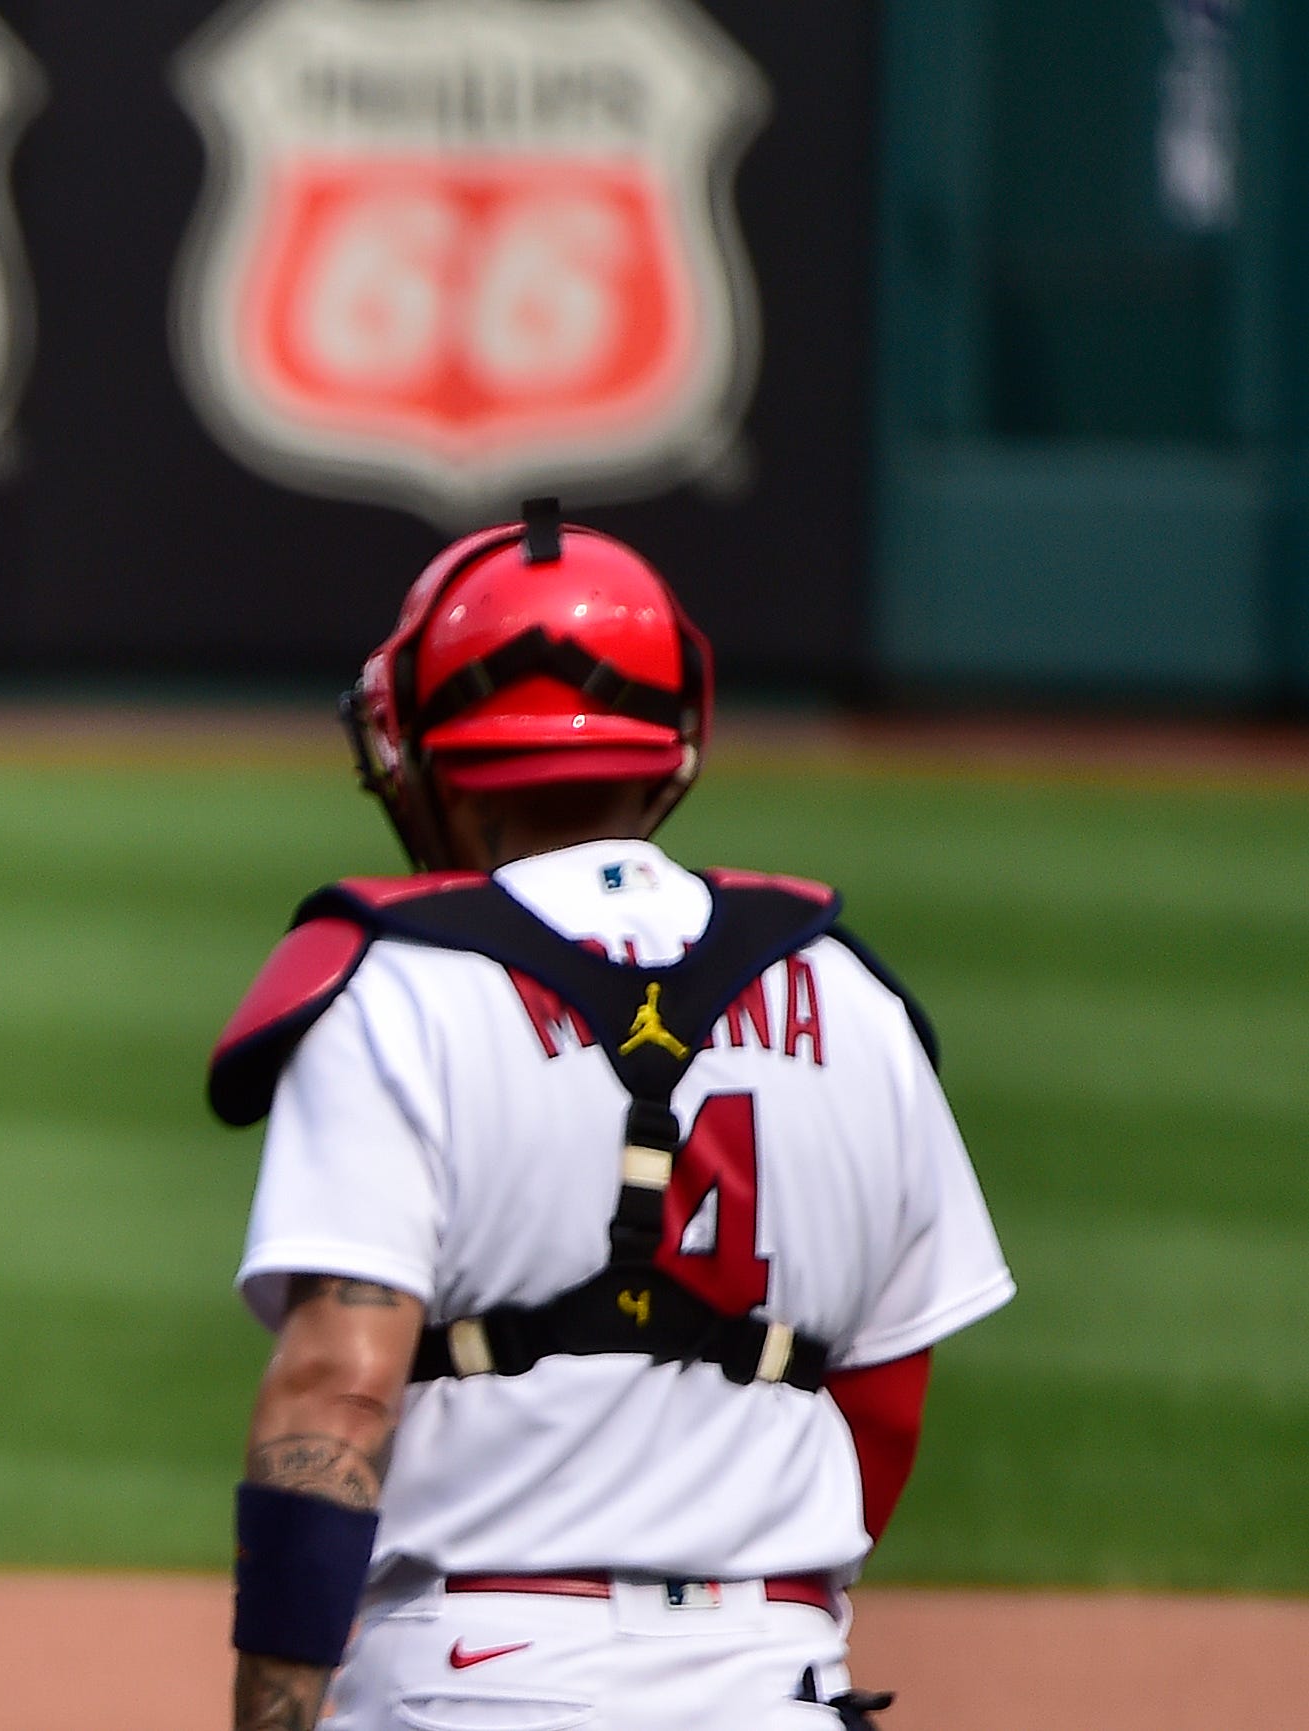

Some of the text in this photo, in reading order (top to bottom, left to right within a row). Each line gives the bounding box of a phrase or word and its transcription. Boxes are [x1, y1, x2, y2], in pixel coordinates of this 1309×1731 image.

[304, 198, 618, 380] 66
[652, 1092, 770, 1320] 4
[616, 1288, 652, 1327] 4
